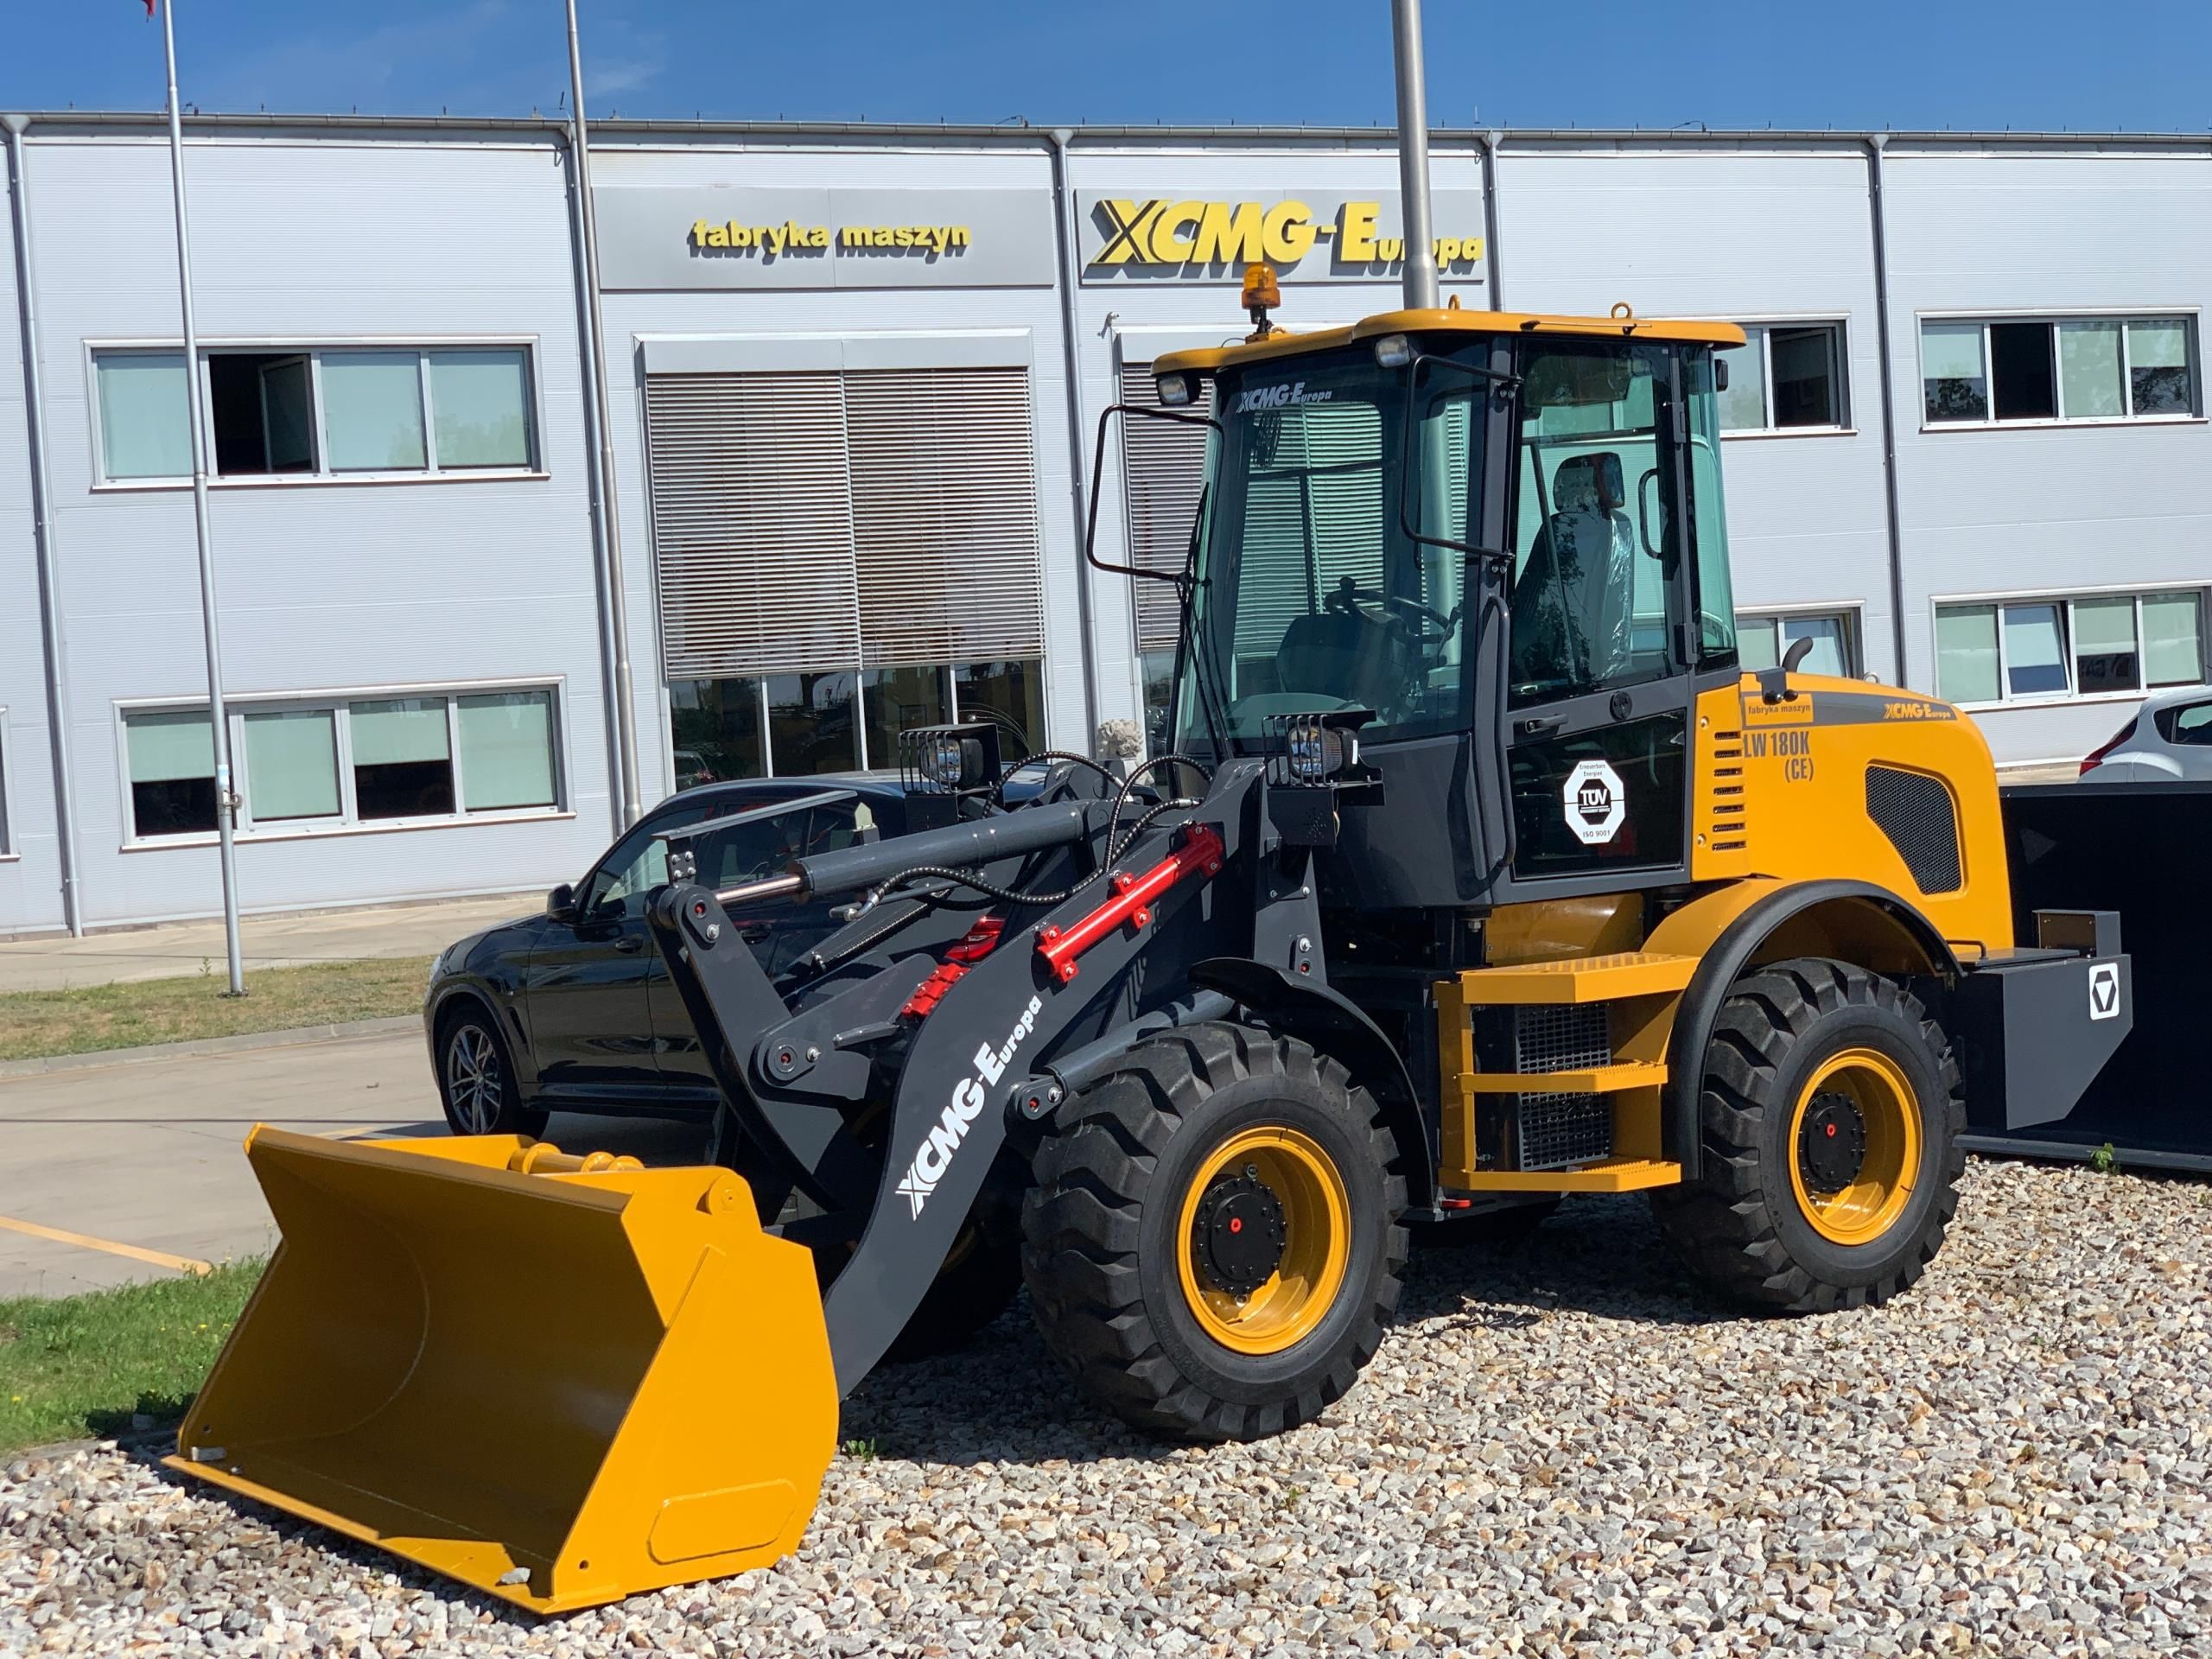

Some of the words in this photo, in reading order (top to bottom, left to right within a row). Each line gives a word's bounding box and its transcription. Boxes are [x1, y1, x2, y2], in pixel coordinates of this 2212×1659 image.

[693, 218, 830, 254] fabryka
[842, 226, 970, 252] maszyn
[1090, 200, 1484, 268] XCMG-Eupa
[1235, 382, 1332, 413] XCMG-Europa
[1748, 704, 1779, 715] fabryka
[1781, 704, 1811, 714] maszyn
[1785, 758, 1814, 783] (CE)
[1580, 788, 1607, 805] TÜV
[895, 995, 1042, 1221] XCMG-Europa
